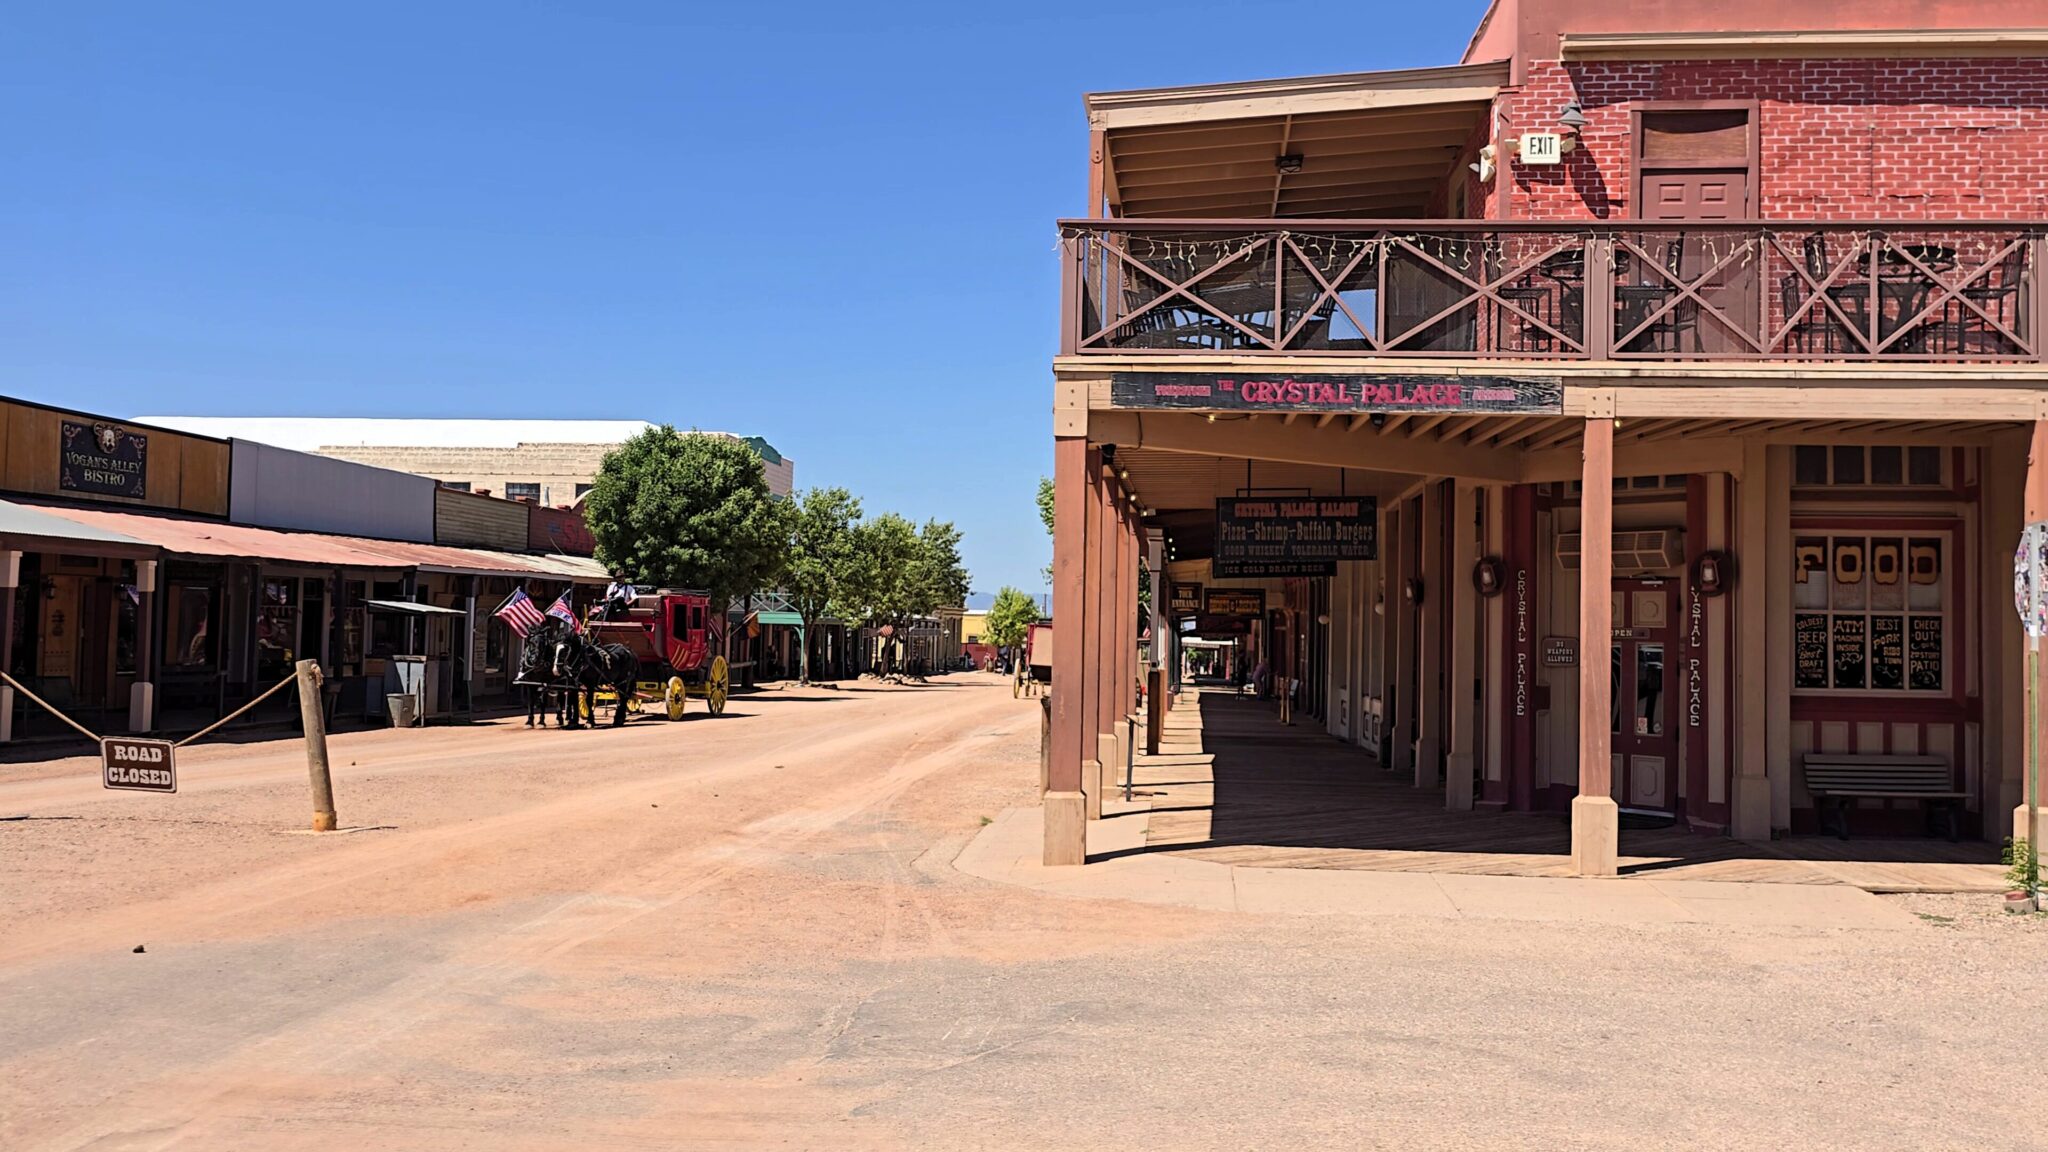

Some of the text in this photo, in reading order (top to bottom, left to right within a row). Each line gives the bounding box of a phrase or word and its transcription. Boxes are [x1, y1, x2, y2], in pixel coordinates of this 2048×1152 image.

[1530, 136, 1554, 155] EXIT
[1217, 380, 1235, 391] THE
[1241, 379, 1354, 404] CRYSTAL
[1361, 383, 1463, 406] PALACE
[66, 451, 142, 474] VOGAN'S ALLEY
[84, 469, 126, 486] BISTRO
[1234, 502, 1359, 518] CRYSTAL PALACE SALOON
[1335, 521, 1373, 544] Burgers
[1247, 545, 1285, 556] WHISKEY
[1291, 545, 1338, 556] TOLERABLE
[1341, 545, 1369, 556] WATER
[1224, 566, 1239, 574] ICE
[1243, 566, 1265, 574] COLD
[1269, 565, 1298, 573] DRAFT
[1796, 545, 1937, 583] FOOD
[1171, 599, 1199, 608] ENTRANCE
[1833, 620, 1864, 633] ATM
[1876, 619, 1899, 631] BEST
[1914, 620, 1940, 630] CHECK
[1516, 570, 1526, 716] CRYSTAL PALACE
[1798, 631, 1827, 643] BEER
[1833, 634, 1864, 642] MACHINE
[1873, 633, 1900, 650] PORK
[1915, 631, 1934, 641] OUT
[1836, 644, 1860, 652] INSIDE
[1690, 586, 1701, 726] YSTAL PALACE
[1799, 660, 1824, 668] DRAFT
[1910, 660, 1940, 674] PATIO
[114, 745, 163, 762] ROAD
[108, 766, 172, 785] CLOSED
